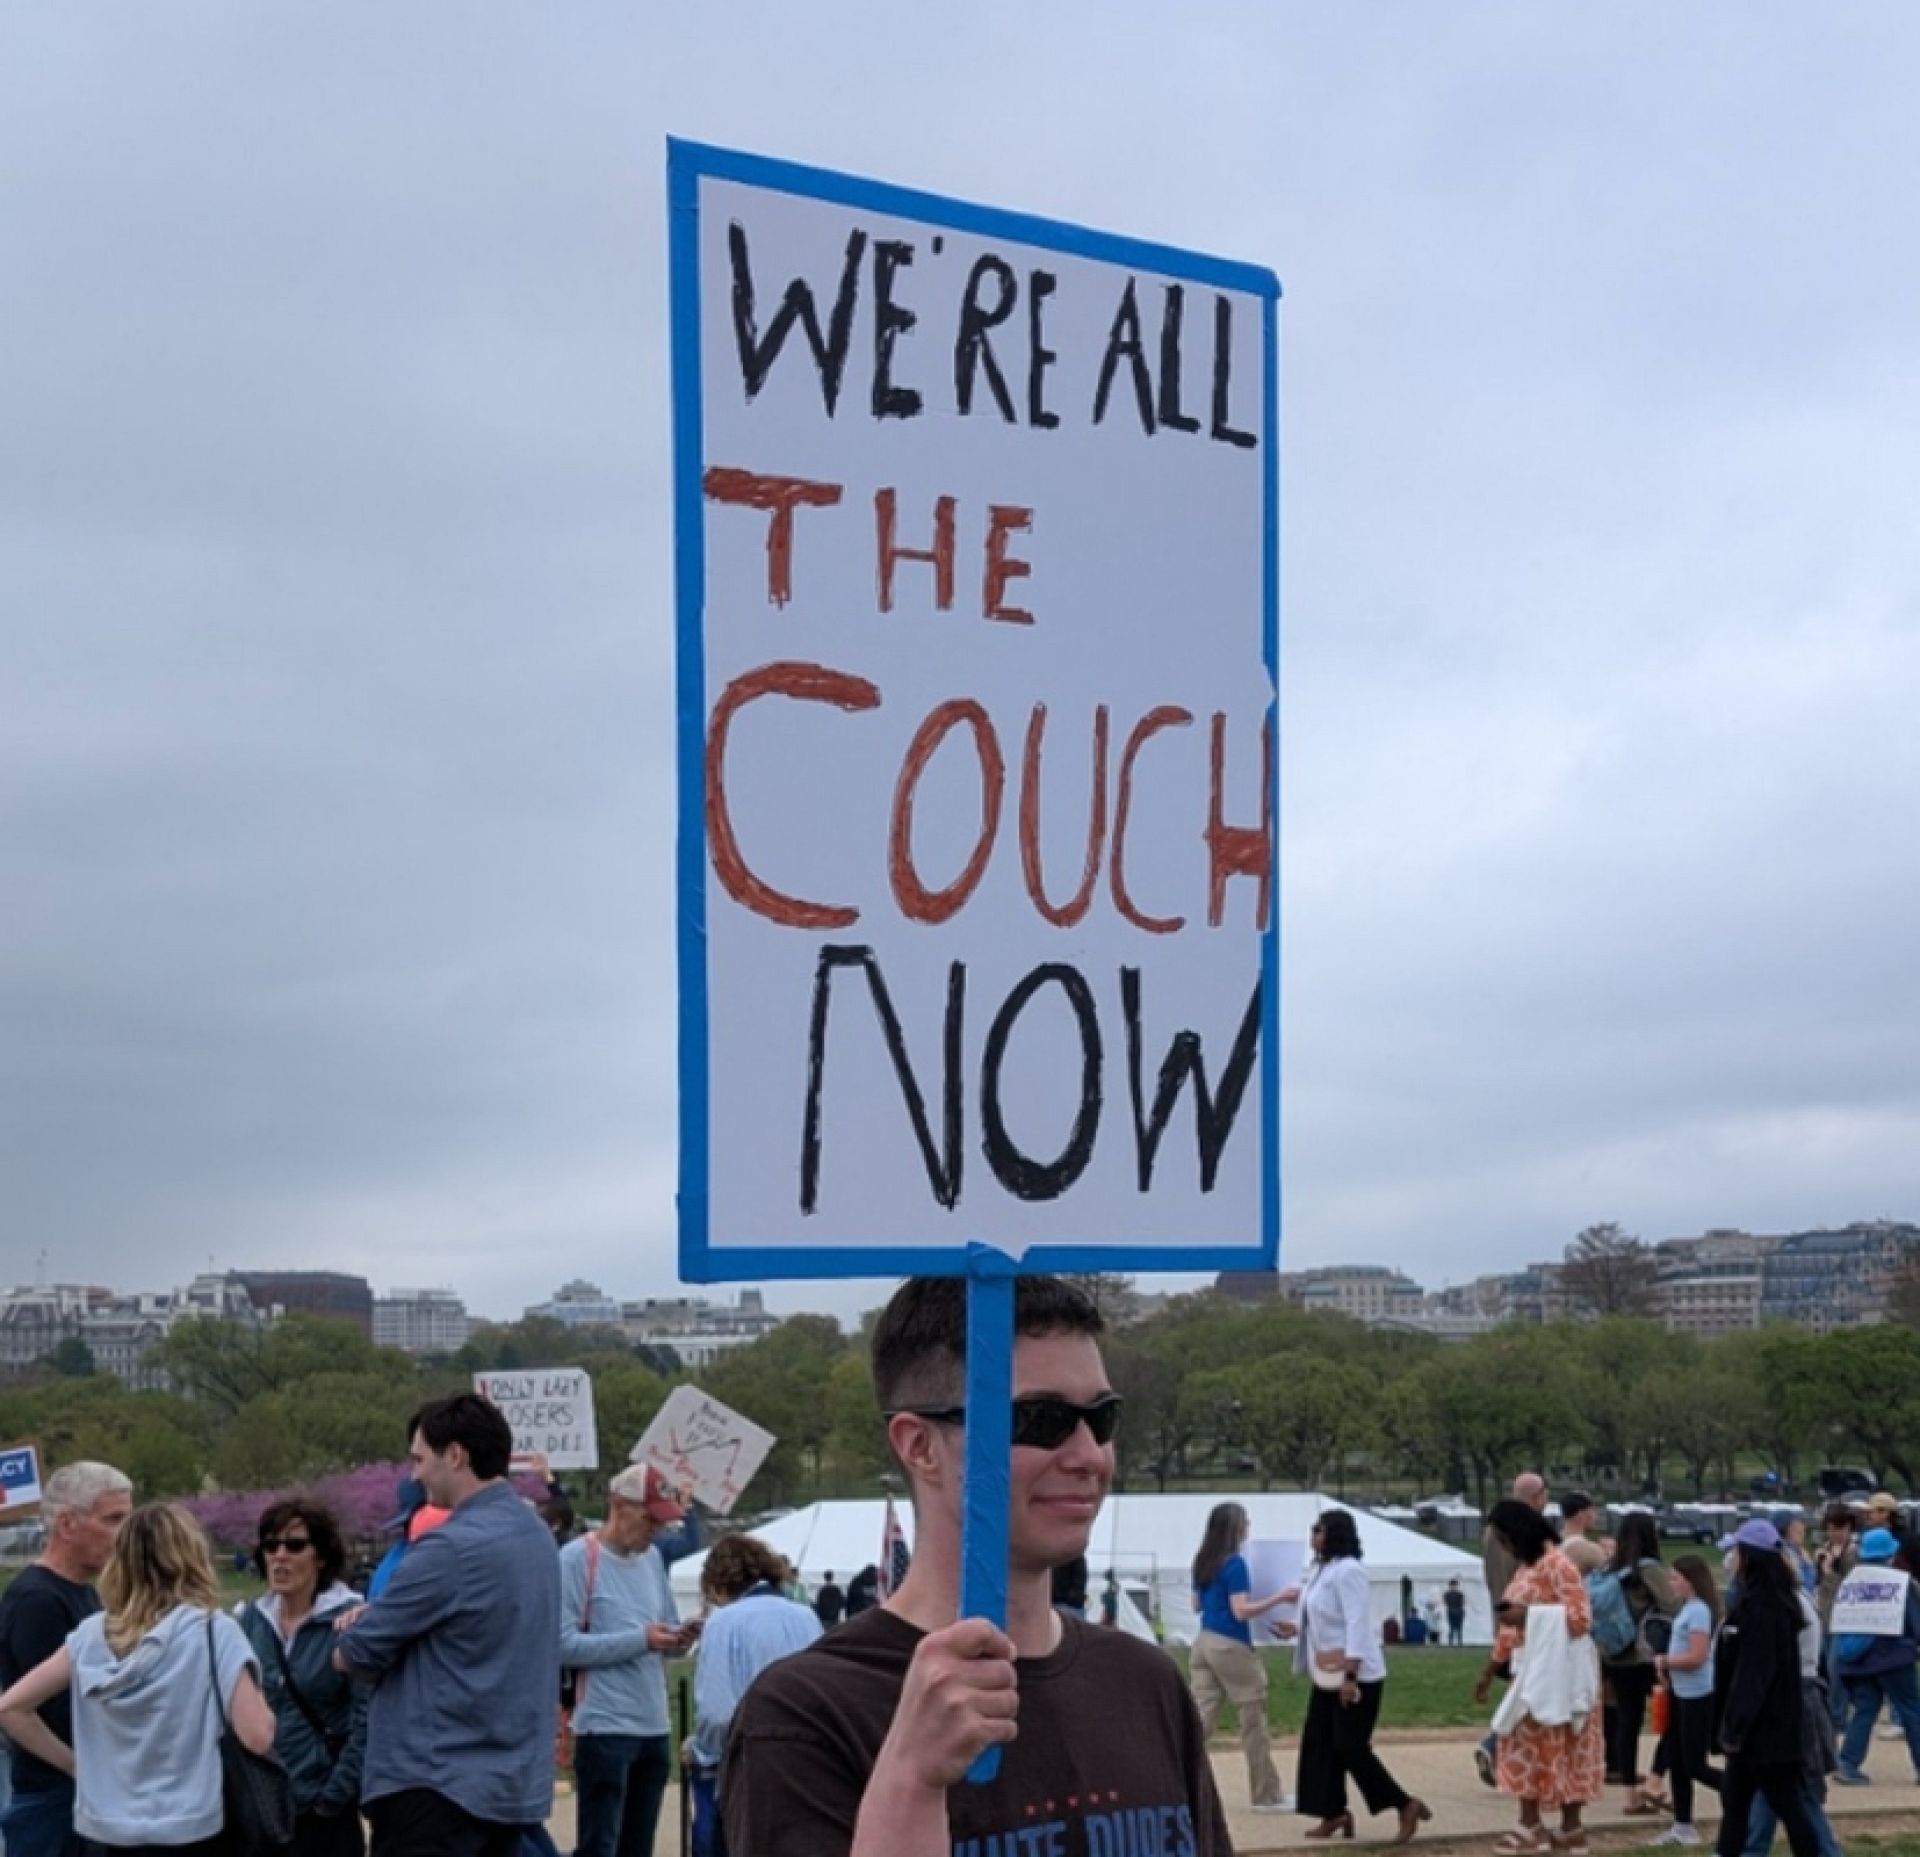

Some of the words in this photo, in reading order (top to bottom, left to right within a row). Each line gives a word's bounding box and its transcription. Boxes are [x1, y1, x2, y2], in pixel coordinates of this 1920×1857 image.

[729, 217, 1060, 428] WE'RE
[1093, 276, 1258, 450] ALL
[702, 465, 1036, 625] THE
[704, 660, 1273, 934] COUCH
[800, 944, 1263, 1215] NOW
[0, 1458, 27, 1478] CY
[507, 1401, 575, 1428] OSERS
